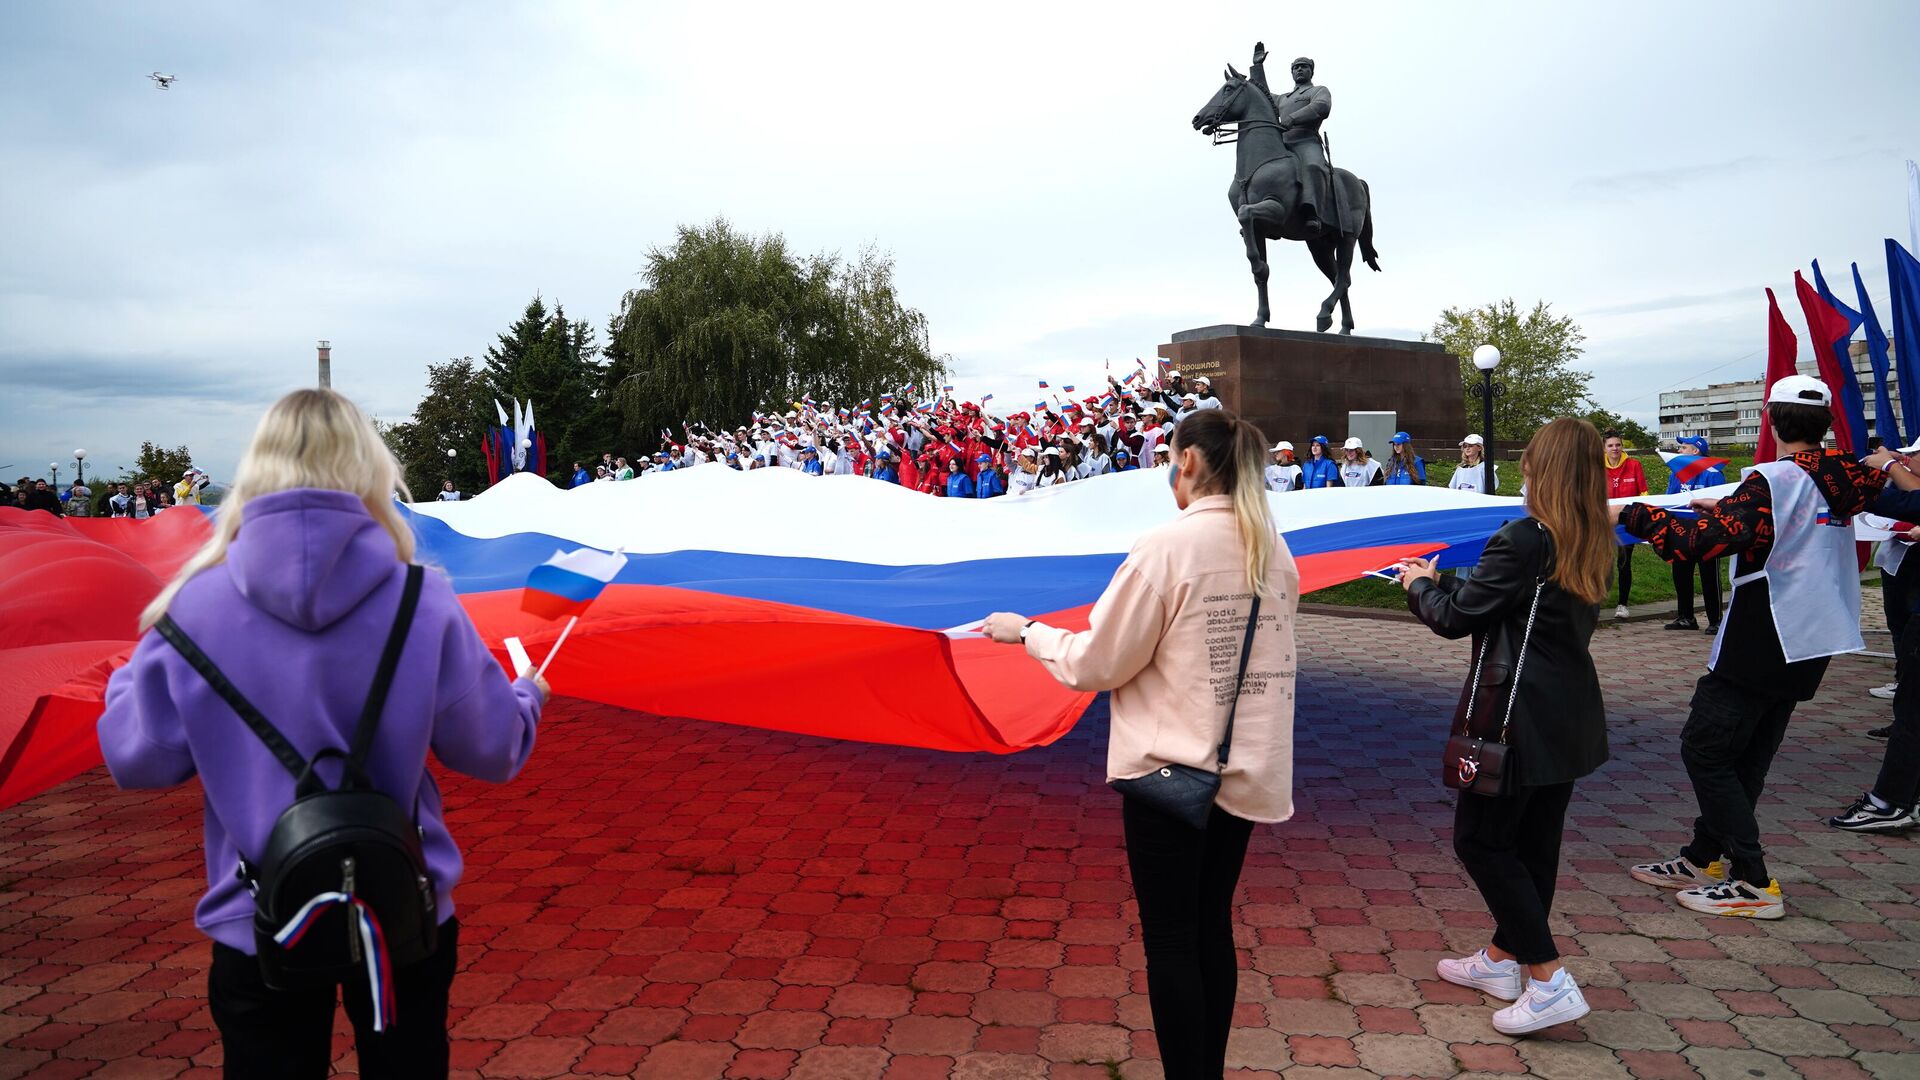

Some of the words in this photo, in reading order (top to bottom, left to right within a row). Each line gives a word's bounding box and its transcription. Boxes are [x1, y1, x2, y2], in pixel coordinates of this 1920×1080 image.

[1175, 361, 1220, 372] Ворошилов
[1823, 474, 1841, 496] 1978
[1206, 609, 1237, 618] vodka
